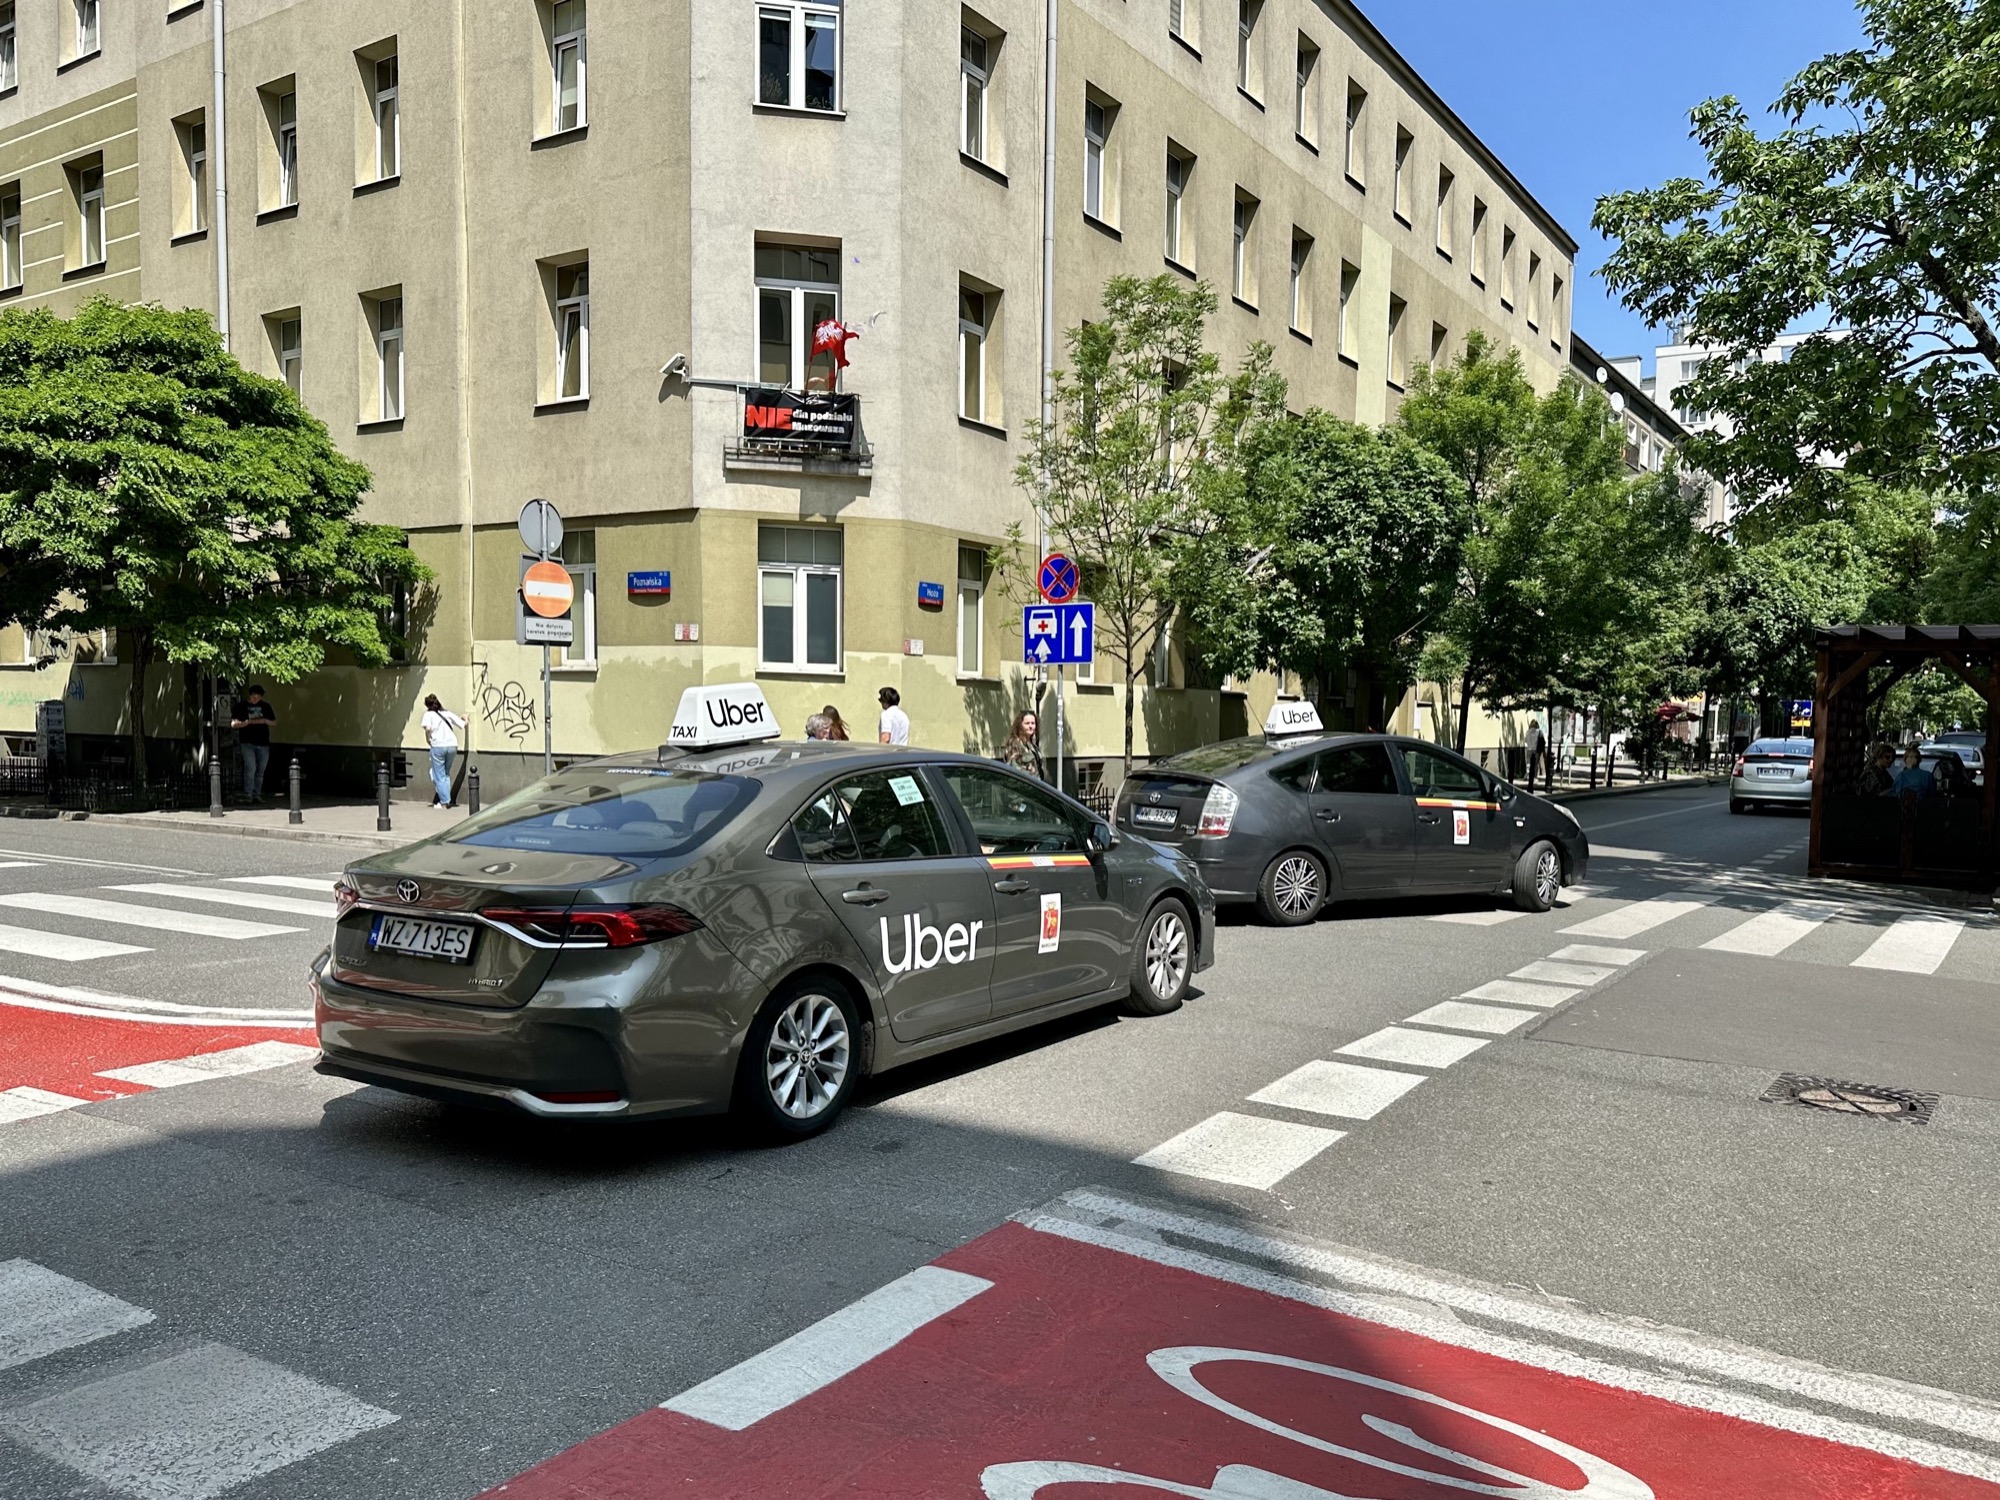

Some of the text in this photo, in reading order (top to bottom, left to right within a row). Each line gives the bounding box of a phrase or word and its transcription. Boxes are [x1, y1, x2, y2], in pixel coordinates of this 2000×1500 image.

[746, 405, 853, 430] NIE dla podziału
[792, 422, 845, 434] Mazowsza
[633, 577, 662, 587] Poznańska
[706, 698, 764, 728] Uber
[1281, 709, 1314, 725] Uber
[672, 725, 697, 738] TAXI
[381, 918, 407, 946] WZ
[408, 922, 469, 955] 713ES
[879, 912, 984, 974] Uber
